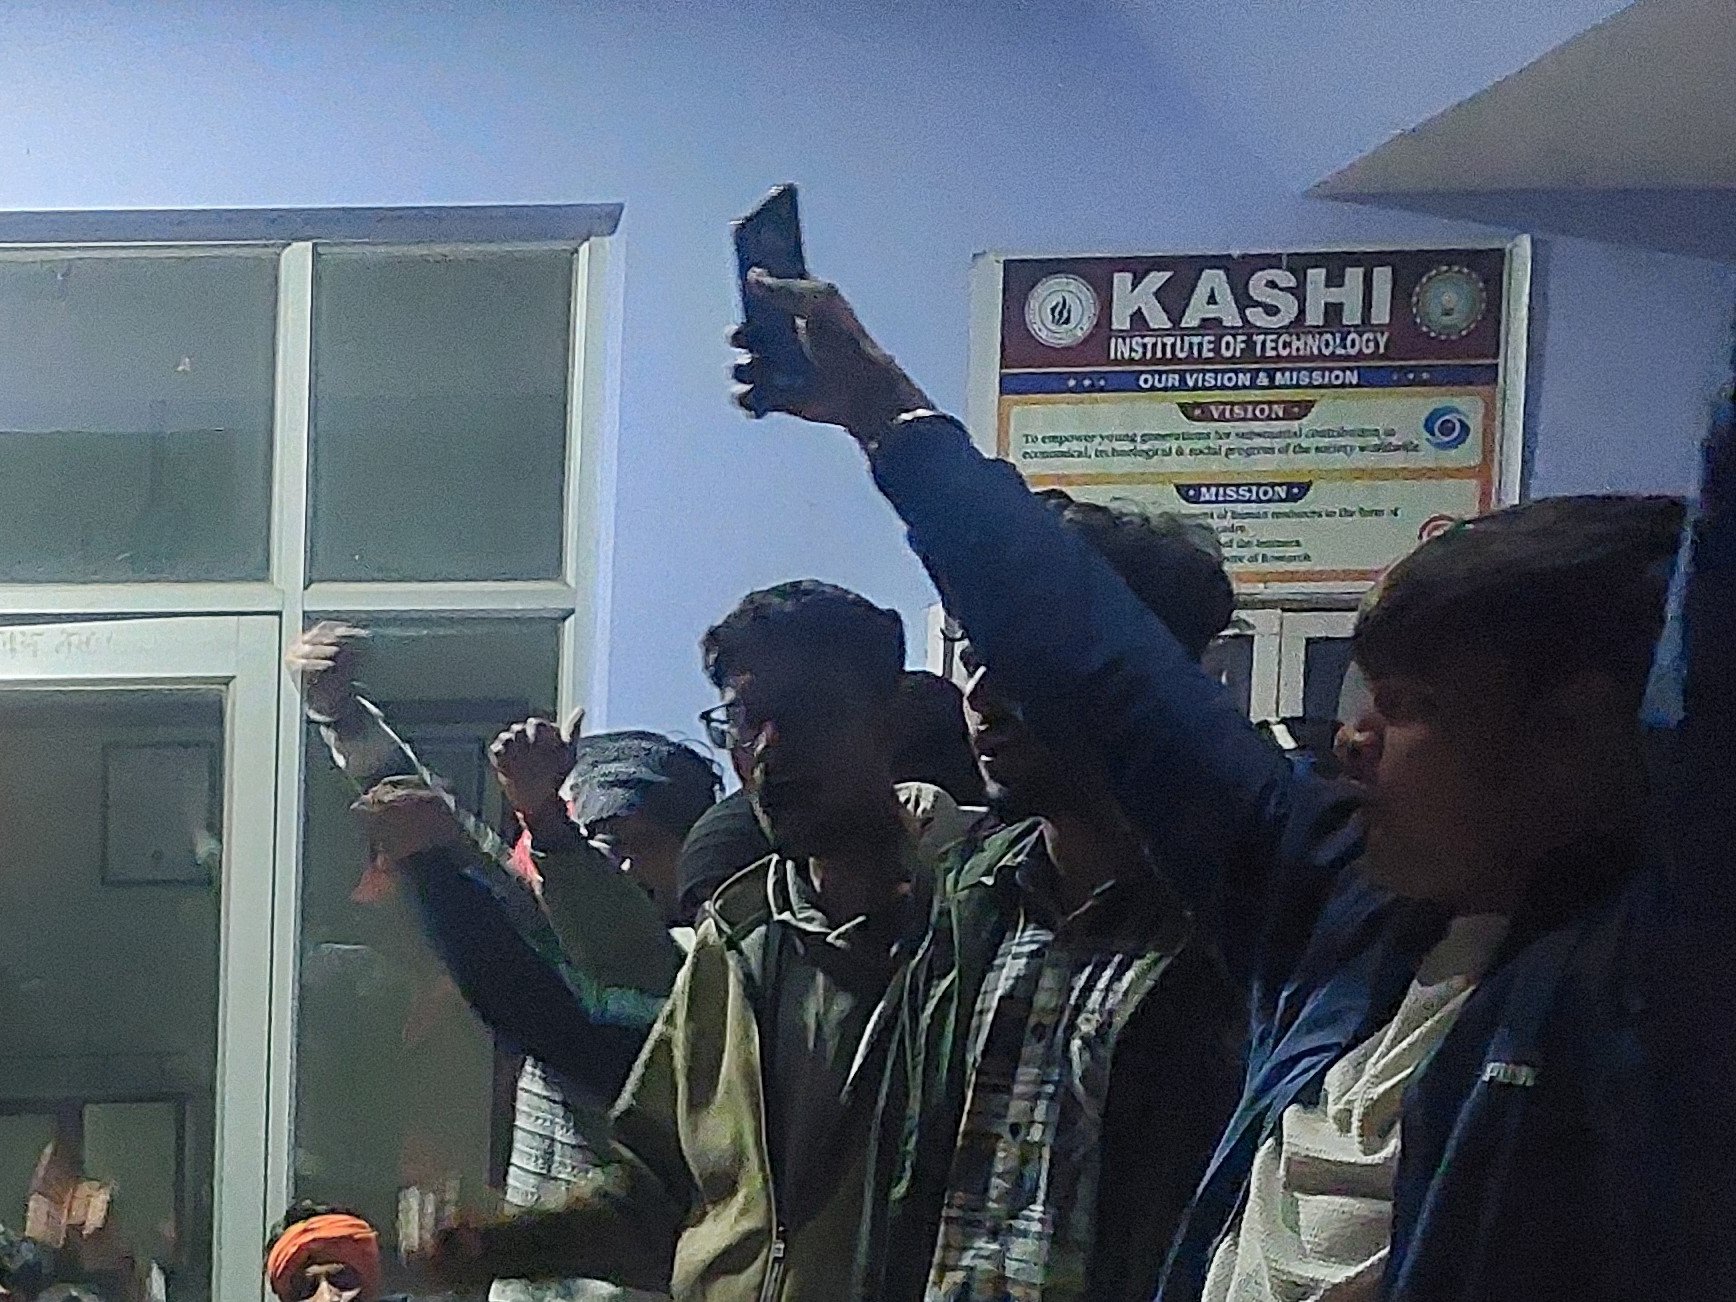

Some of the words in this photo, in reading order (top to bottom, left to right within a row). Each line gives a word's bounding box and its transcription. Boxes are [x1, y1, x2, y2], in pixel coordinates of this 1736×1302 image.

[1110, 265, 1393, 331] KASHI
[1110, 336, 1214, 360] INSTITUTE
[1221, 335, 1247, 358] OF
[1253, 332, 1390, 357] TECHNOLOGY
[1138, 373, 1180, 388] OUR
[1186, 372, 1251, 388] VISION
[1275, 370, 1359, 386] MISSION
[1210, 404, 1284, 420] VISION
[1023, 433, 1038, 444] To
[1200, 486, 1288, 501] MISSION
